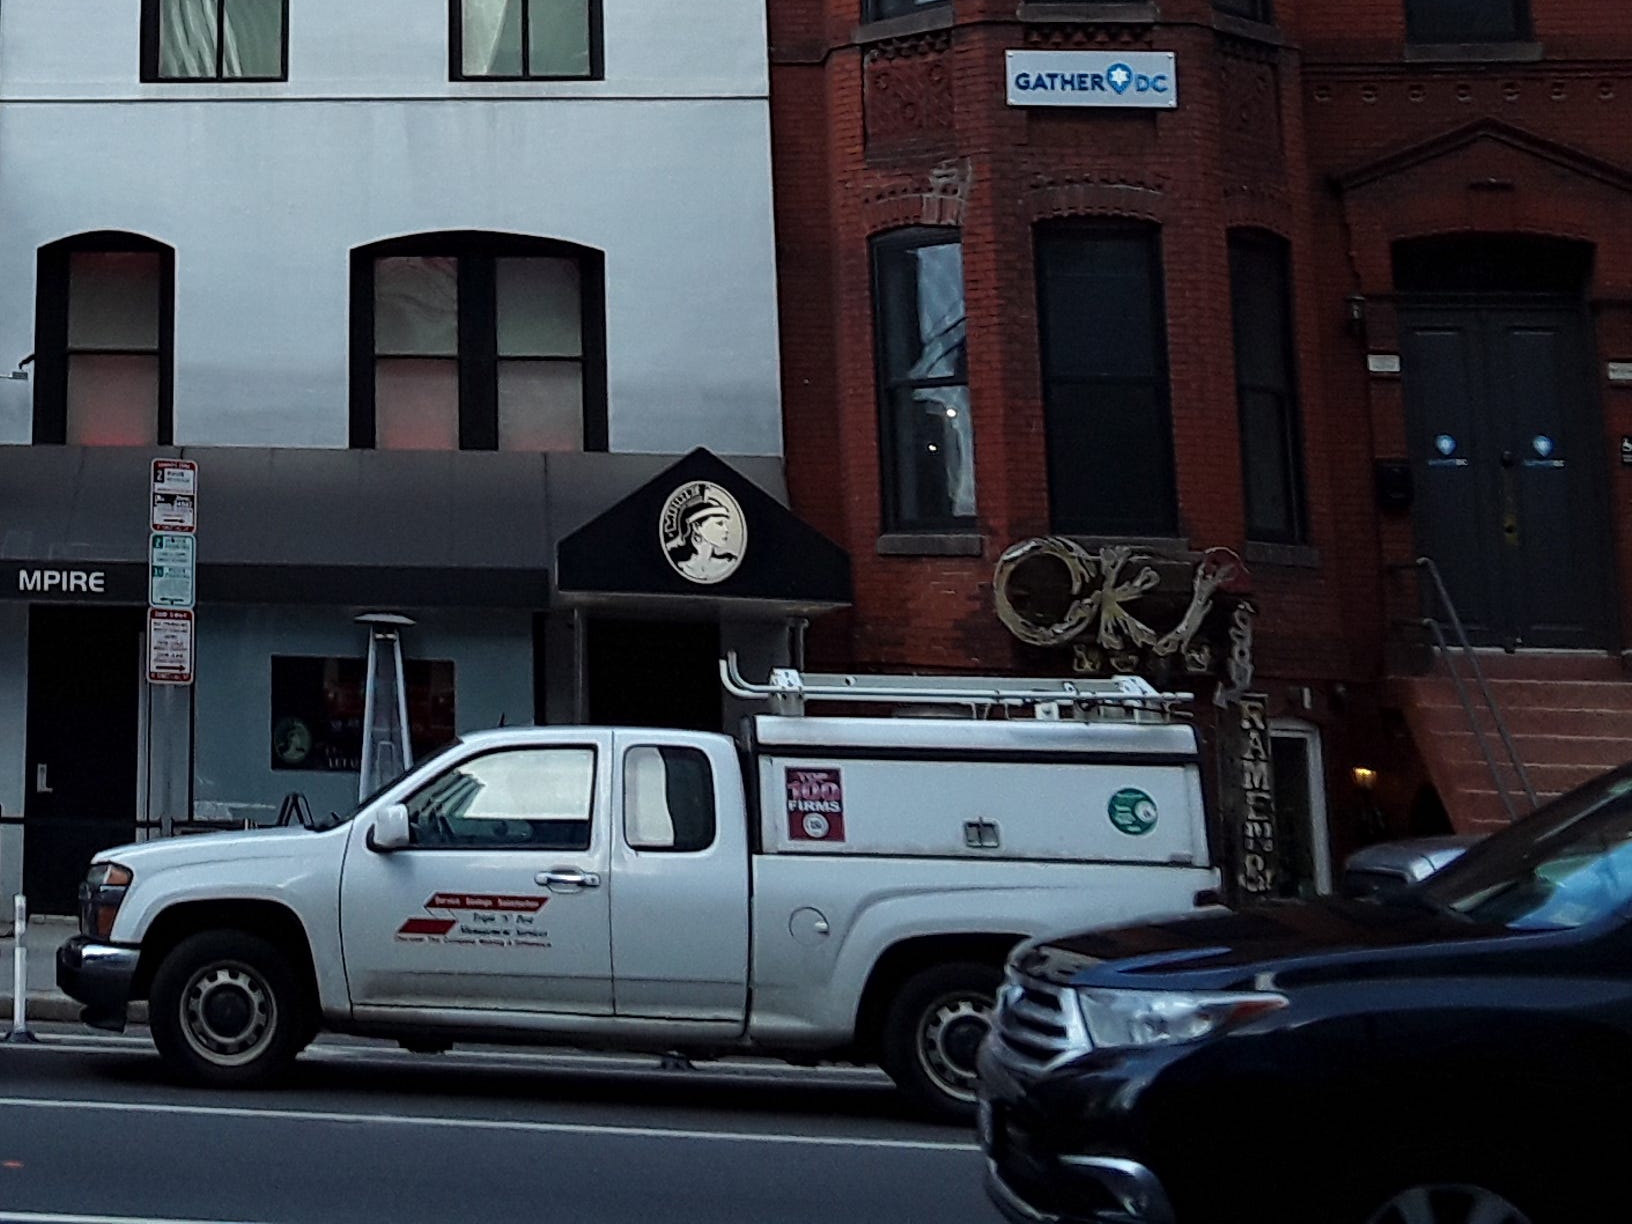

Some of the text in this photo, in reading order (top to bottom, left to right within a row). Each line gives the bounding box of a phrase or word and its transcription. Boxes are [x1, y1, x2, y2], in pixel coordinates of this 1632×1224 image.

[1015, 72, 1169, 93] GATHER DC
[19, 569, 105, 593] MPIRE
[796, 771, 829, 783] TOP
[788, 780, 841, 801] 100
[788, 799, 842, 813] FIRMS
